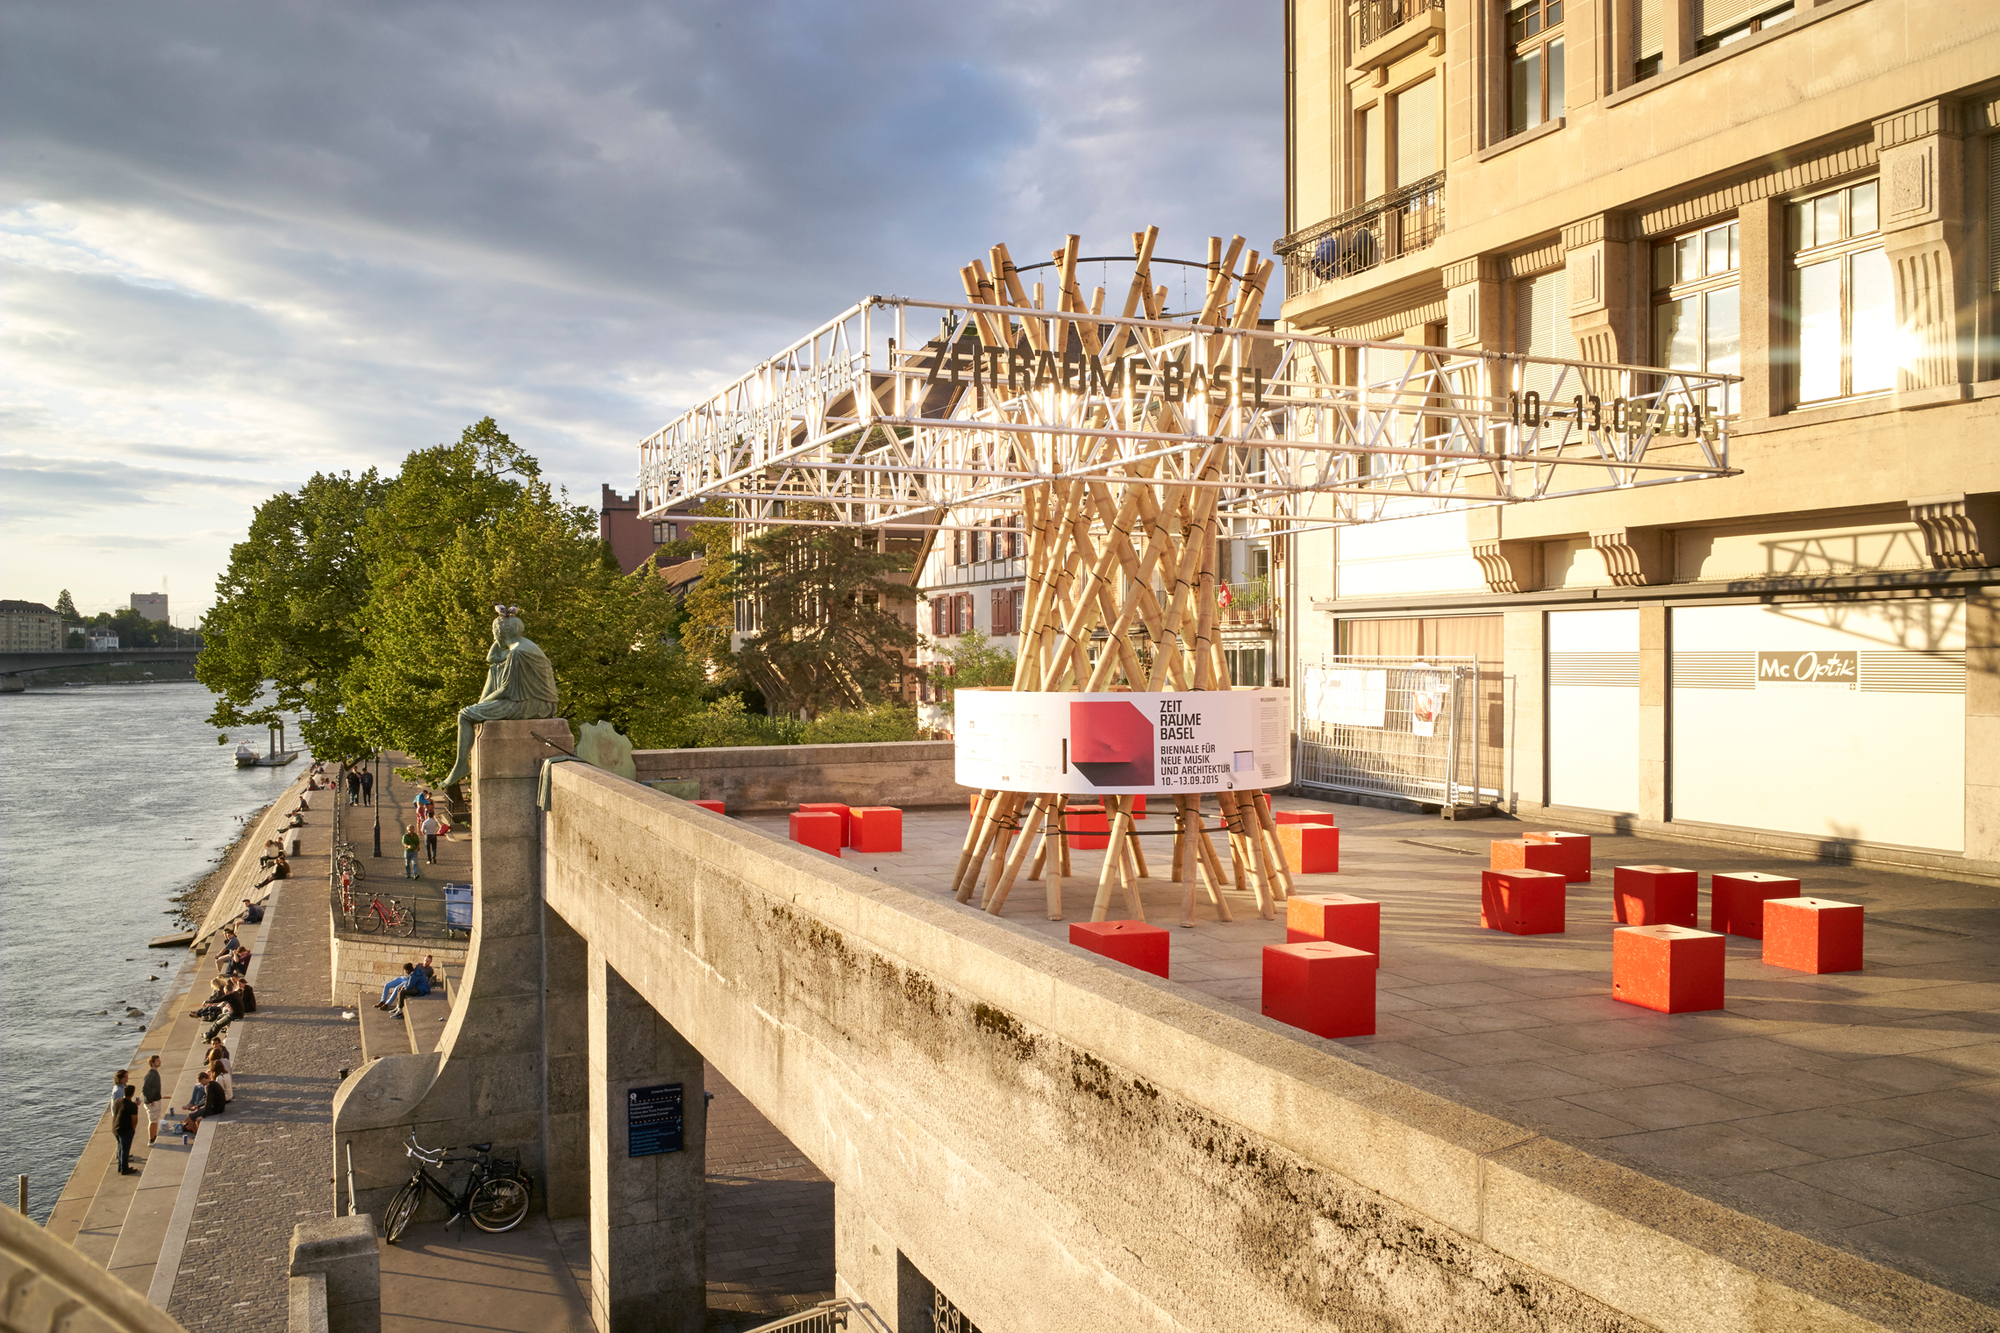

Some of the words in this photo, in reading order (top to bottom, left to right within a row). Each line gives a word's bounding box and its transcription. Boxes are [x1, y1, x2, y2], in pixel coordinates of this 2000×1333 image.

[927, 340, 1150, 400] ZEITRÄUME
[1164, 361, 1269, 409] BASEL
[1760, 658, 1790, 677] Mc
[1793, 651, 1856, 681] Optik
[1160, 700, 1182, 713] ZEIT
[1160, 713, 1201, 727] RÄUME
[1160, 727, 1195, 740] BASEL
[1161, 745, 1199, 755] BIENNALE
[1202, 743, 1216, 754] FÜR
[1161, 756, 1181, 765] NEUE
[1184, 755, 1210, 764] MUSIK
[1161, 766, 1179, 776] UND
[1181, 764, 1231, 775] ARCHITEKTUR
